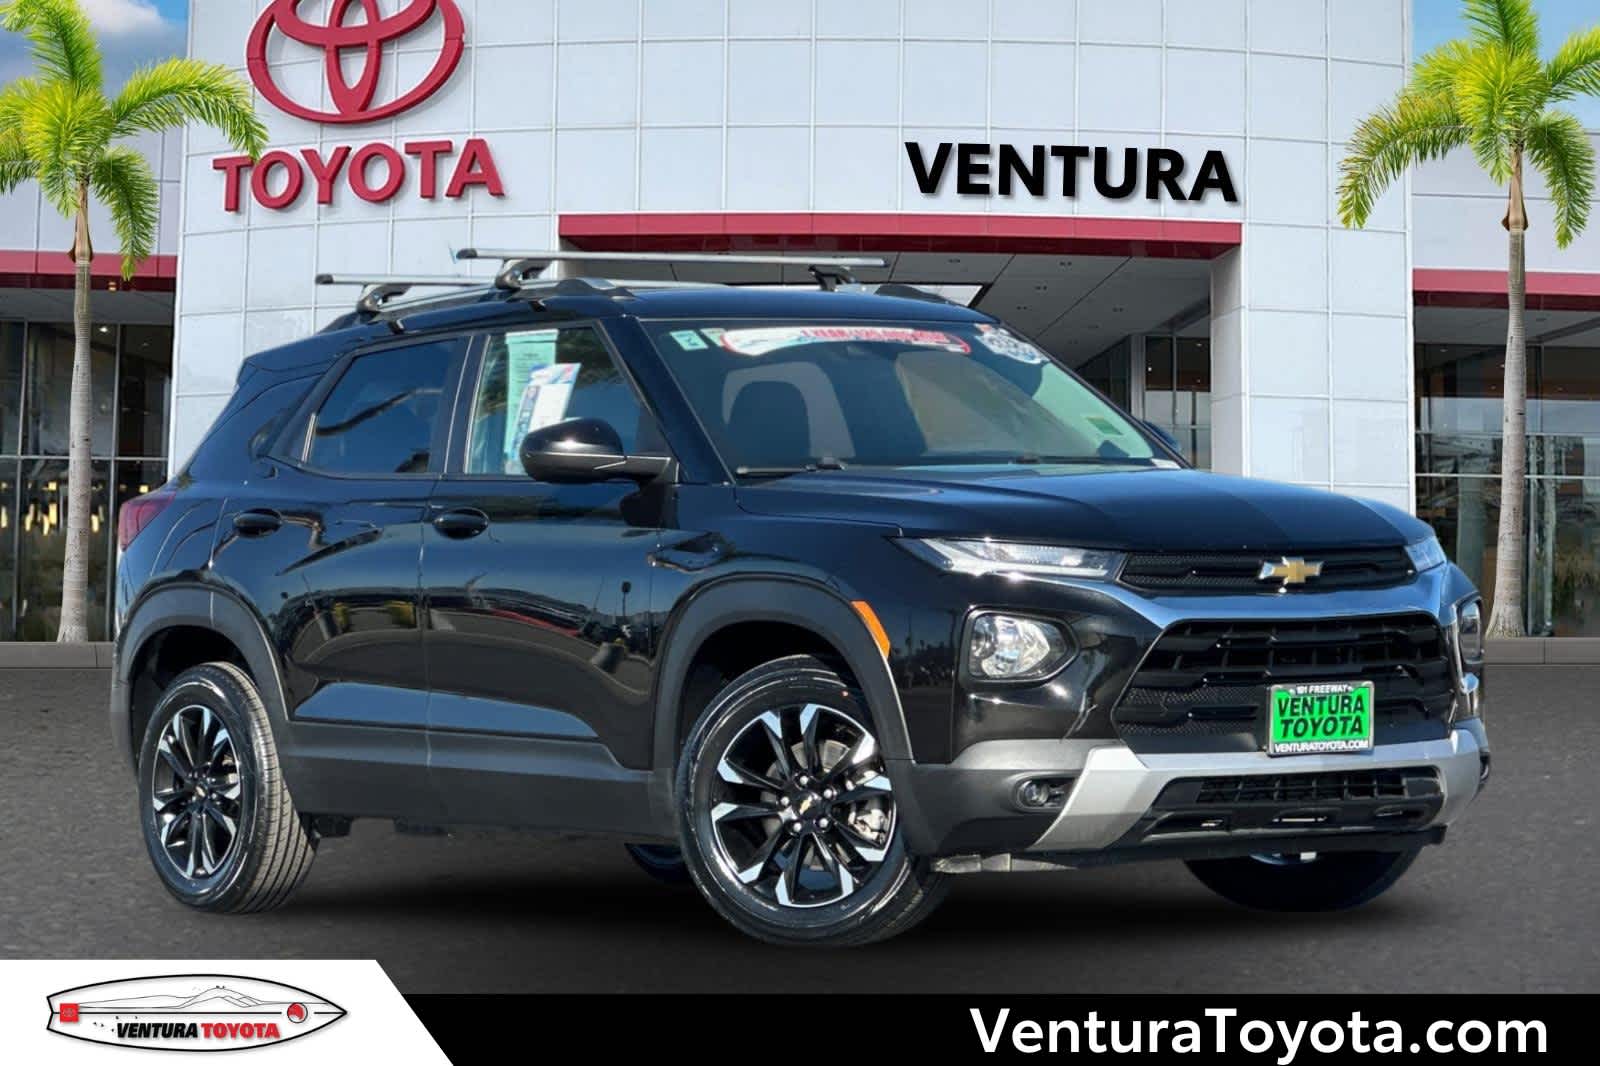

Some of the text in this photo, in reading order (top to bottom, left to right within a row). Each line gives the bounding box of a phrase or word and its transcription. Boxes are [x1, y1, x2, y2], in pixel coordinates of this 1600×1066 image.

[213, 138, 504, 212] TOYOTA
[905, 142, 1238, 203] VENTURA
[1309, 684, 1347, 694] FREEWAY
[1279, 696, 1365, 716] VENTURA
[1281, 717, 1363, 738] TOYOTA
[1275, 742, 1369, 753] VENTURATOYOTA.COM
